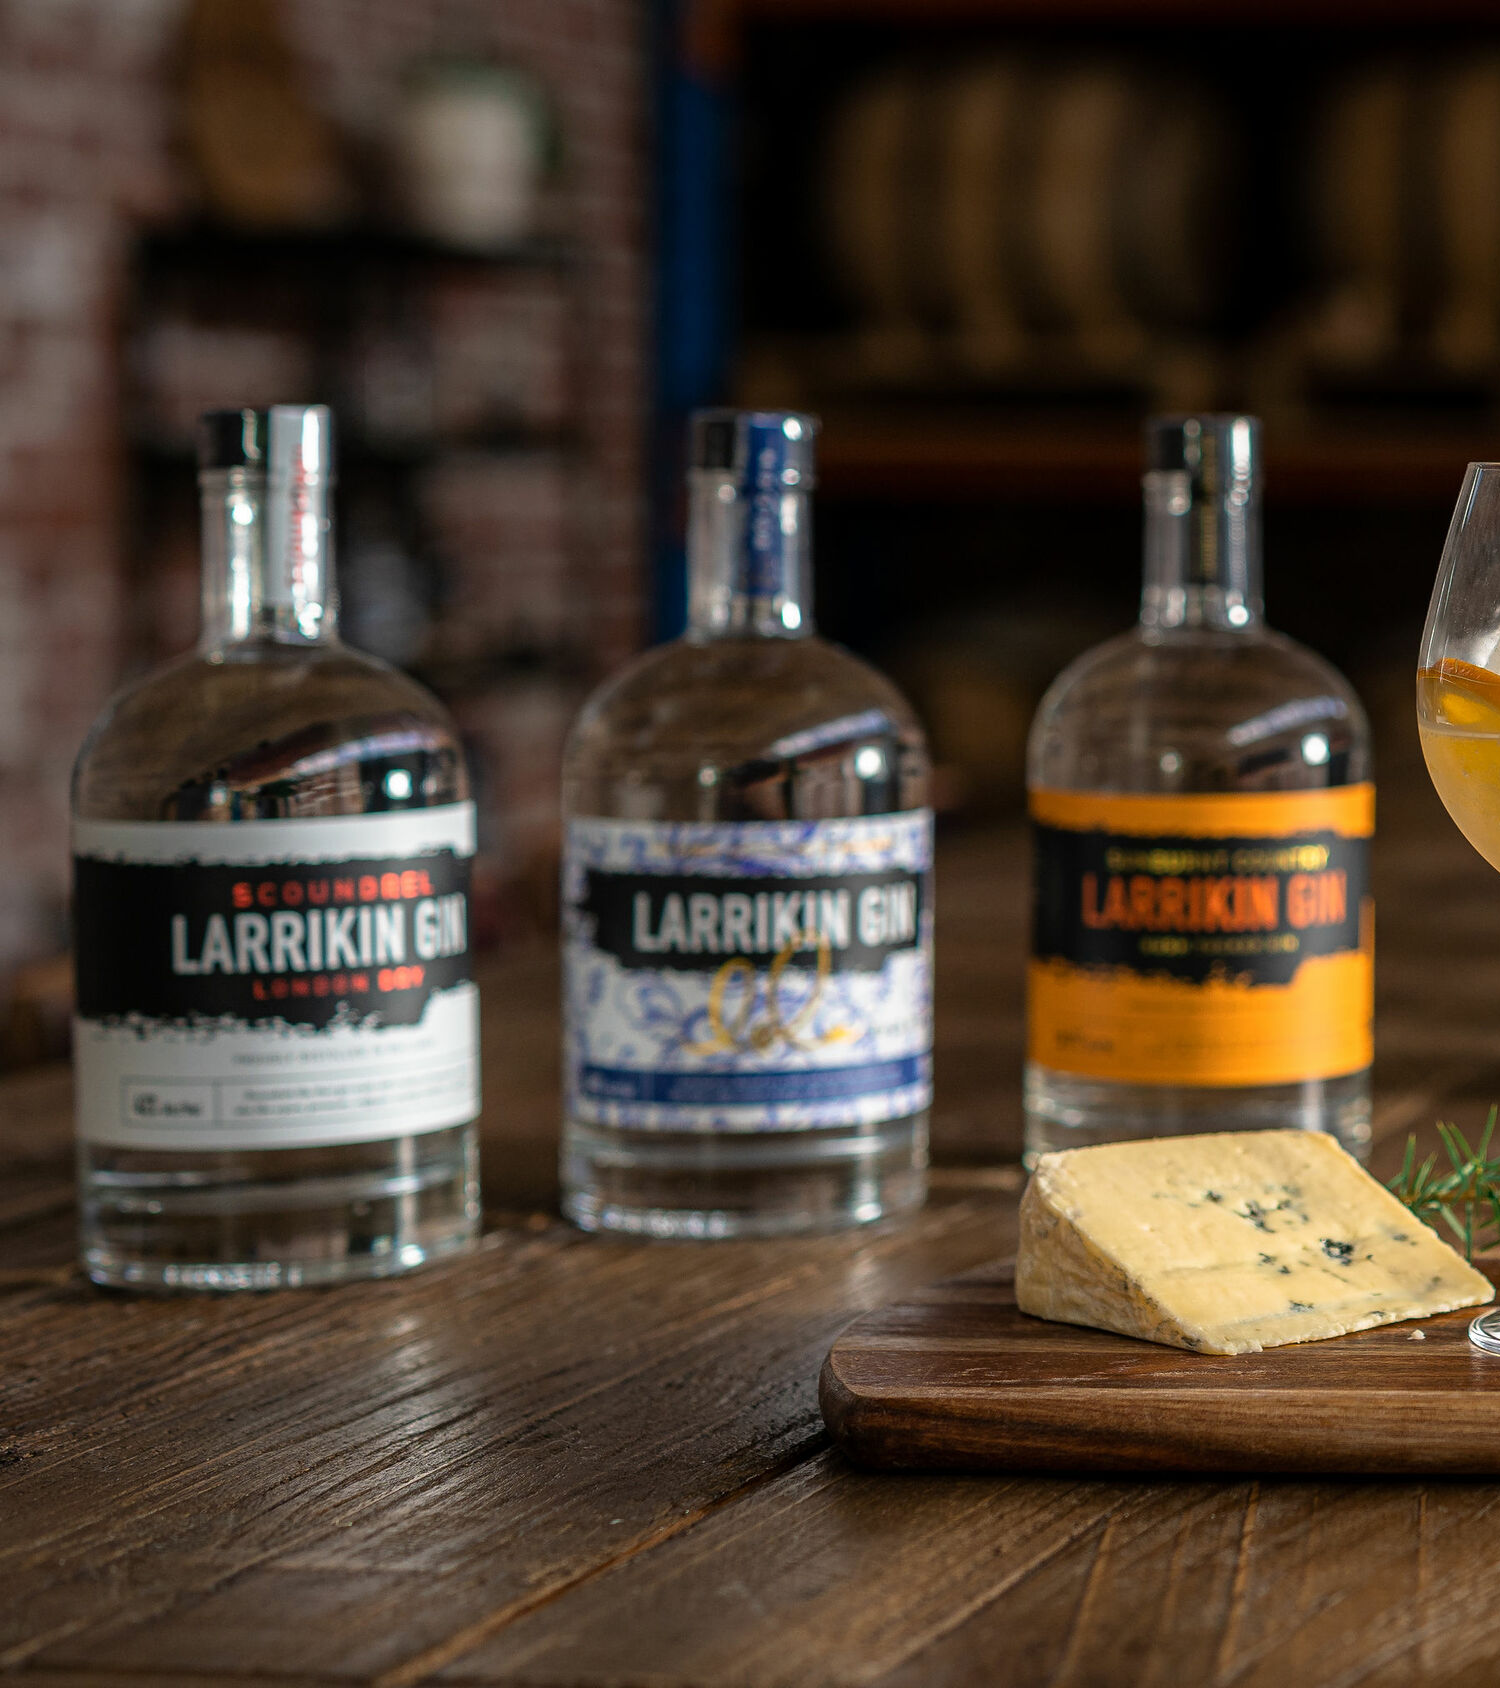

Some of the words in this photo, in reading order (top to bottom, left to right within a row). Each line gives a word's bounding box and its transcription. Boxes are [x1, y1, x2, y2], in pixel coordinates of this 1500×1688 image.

[231, 868, 434, 909] SCOUNDREL
[632, 889, 850, 955] LARRIKIN
[857, 880, 918, 948] GIN
[1080, 871, 1279, 933] LARRIKIN
[1285, 867, 1348, 931] GIN
[170, 900, 407, 976] LARRIKIN
[413, 891, 468, 961] GIN
